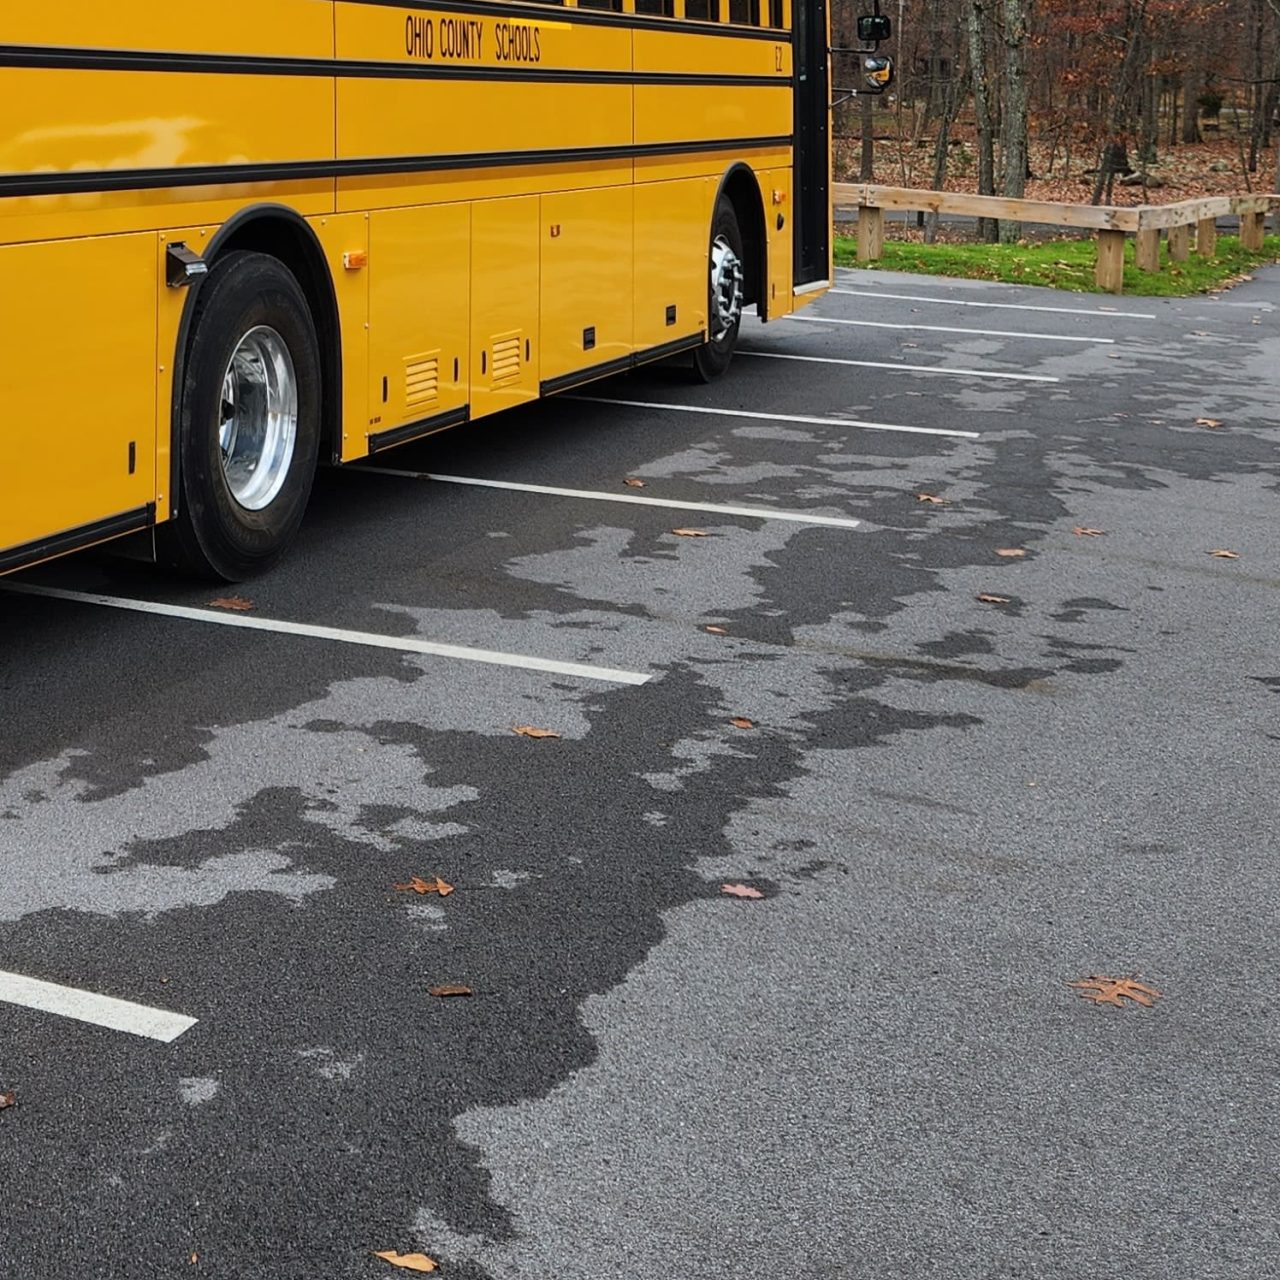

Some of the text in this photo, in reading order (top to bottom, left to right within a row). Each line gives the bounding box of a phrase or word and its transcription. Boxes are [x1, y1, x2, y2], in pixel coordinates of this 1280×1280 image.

[405, 15, 540, 62] OHIO COUNTY SCHOOLS
